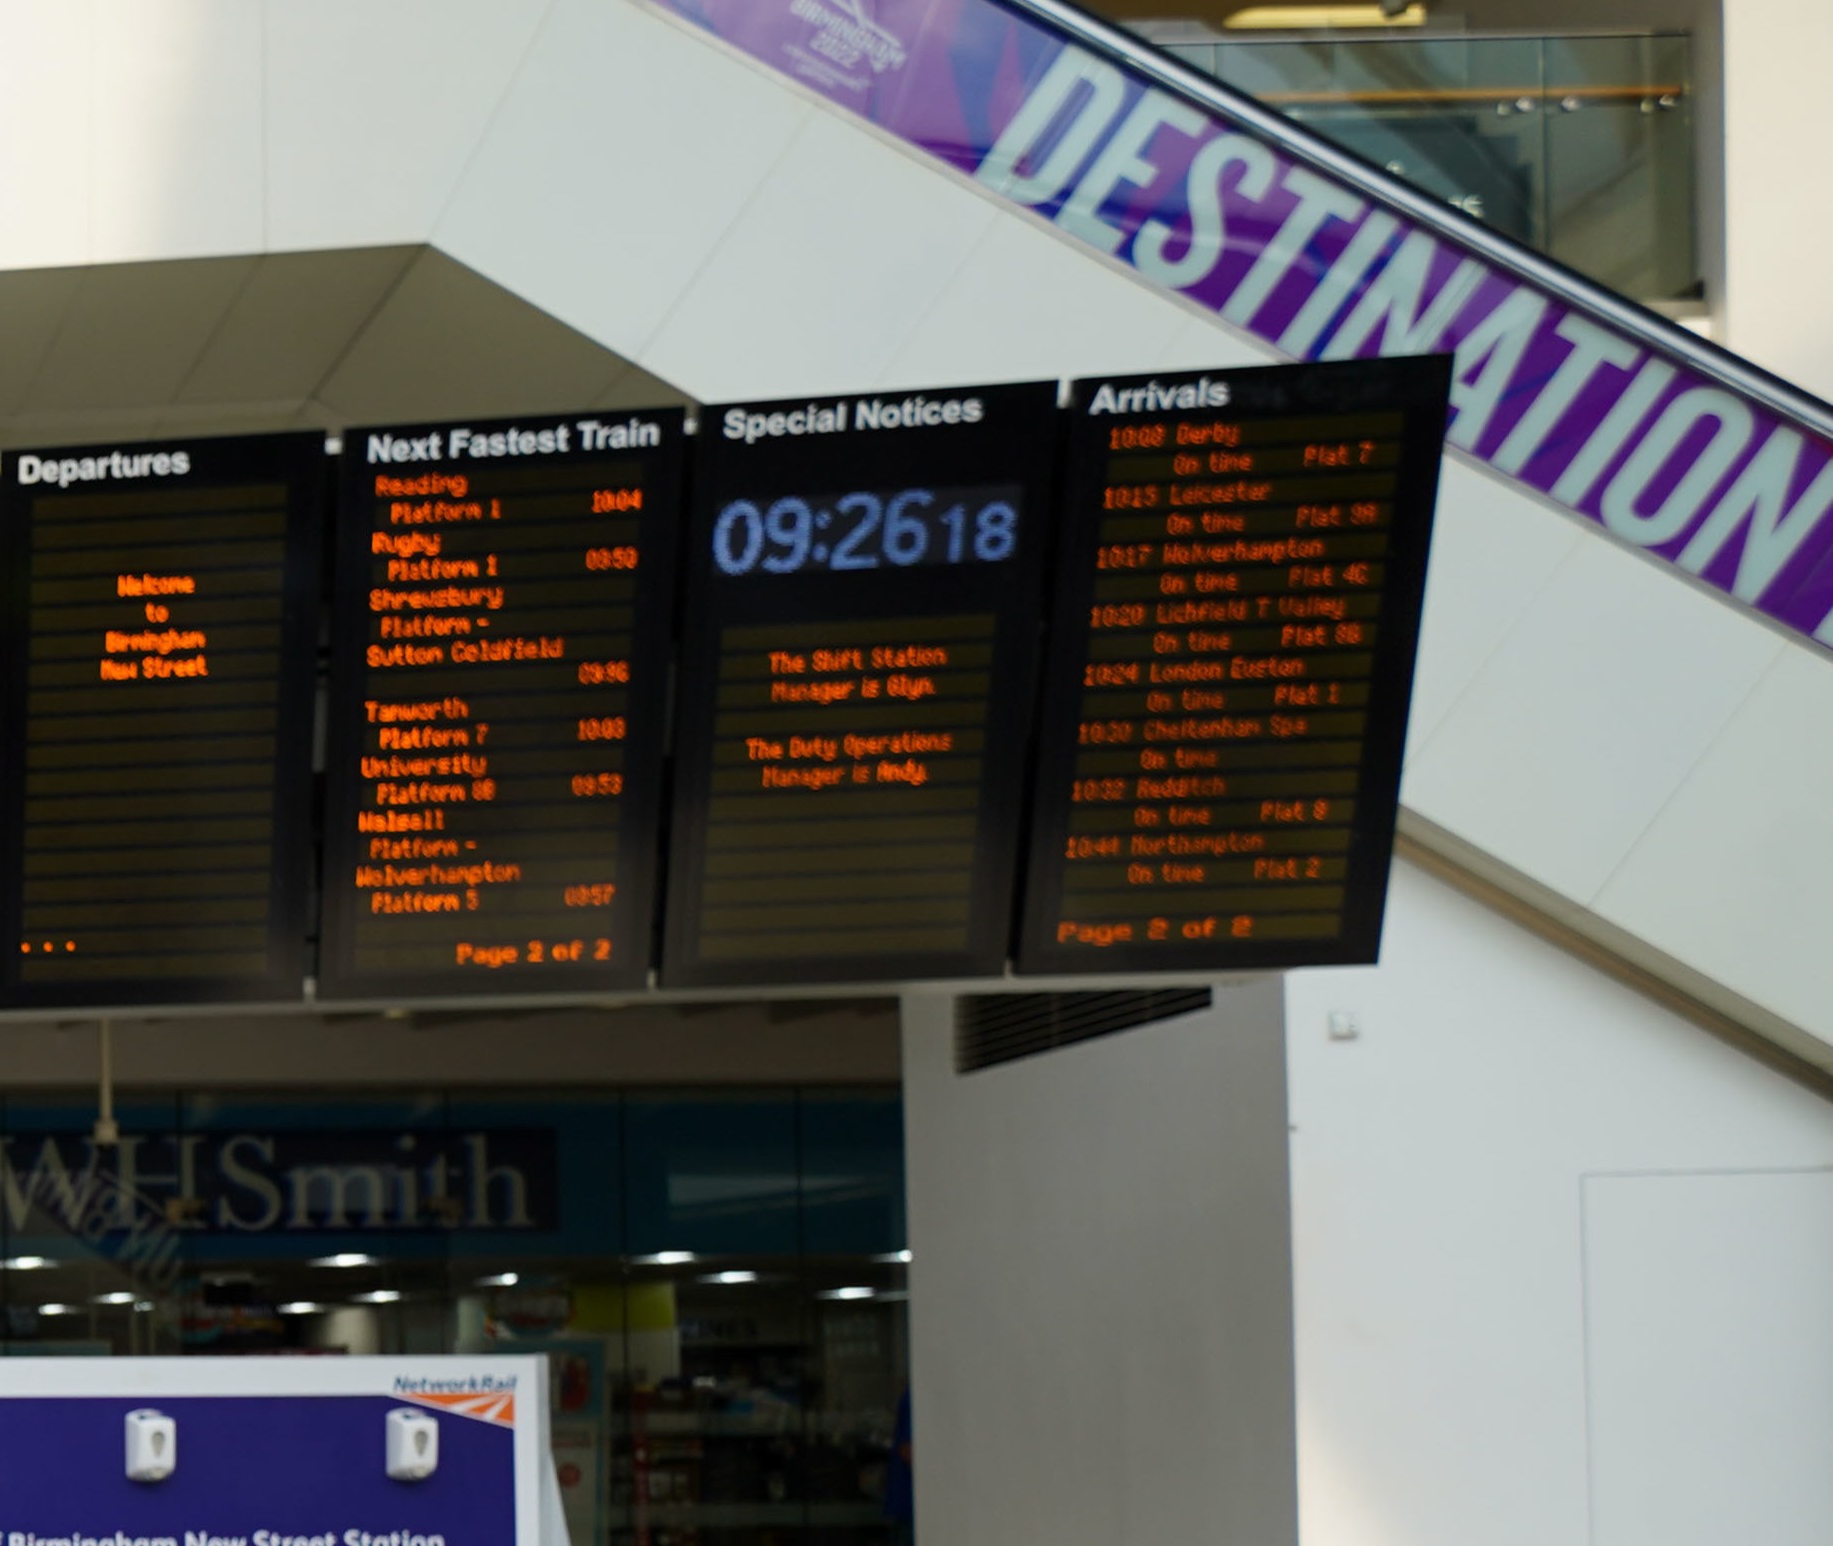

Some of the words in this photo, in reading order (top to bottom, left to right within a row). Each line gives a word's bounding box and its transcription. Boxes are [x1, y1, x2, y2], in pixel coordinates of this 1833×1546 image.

[972, 39, 1833, 608] DESTINATION
[1088, 377, 1231, 416] Arrivals
[723, 402, 847, 444] Special
[854, 397, 985, 432] Notices
[366, 433, 442, 464] Next
[448, 426, 570, 459] Fastest
[576, 421, 660, 452] Train
[17, 449, 190, 488] Departures
[375, 473, 469, 499] Reading
[371, 531, 442, 557] Rugby
[712, 488, 935, 577] 09:26
[940, 500, 1018, 564] 18
[117, 574, 196, 597] Welcome
[369, 586, 504, 610] Shrewsbury
[145, 601, 170, 624] to
[105, 628, 207, 655] Birmingham
[100, 659, 138, 681] New
[142, 654, 208, 679] Street
[366, 645, 443, 668] Sutton
[768, 651, 806, 674] The
[812, 648, 865, 672] Shift
[871, 644, 948, 670] Station
[771, 679, 856, 705] Manager
[861, 677, 880, 700] is
[745, 737, 783, 761] The
[789, 735, 837, 762] Duty
[843, 730, 954, 758] Operations
[361, 755, 489, 779] University
[762, 764, 845, 791] Manager
[852, 764, 871, 784] is
[456, 941, 519, 968] Page
[527, 940, 544, 964] 2
[551, 941, 584, 963] of
[593, 938, 612, 961] 2
[394, 1374, 518, 1395] NetworkRail
